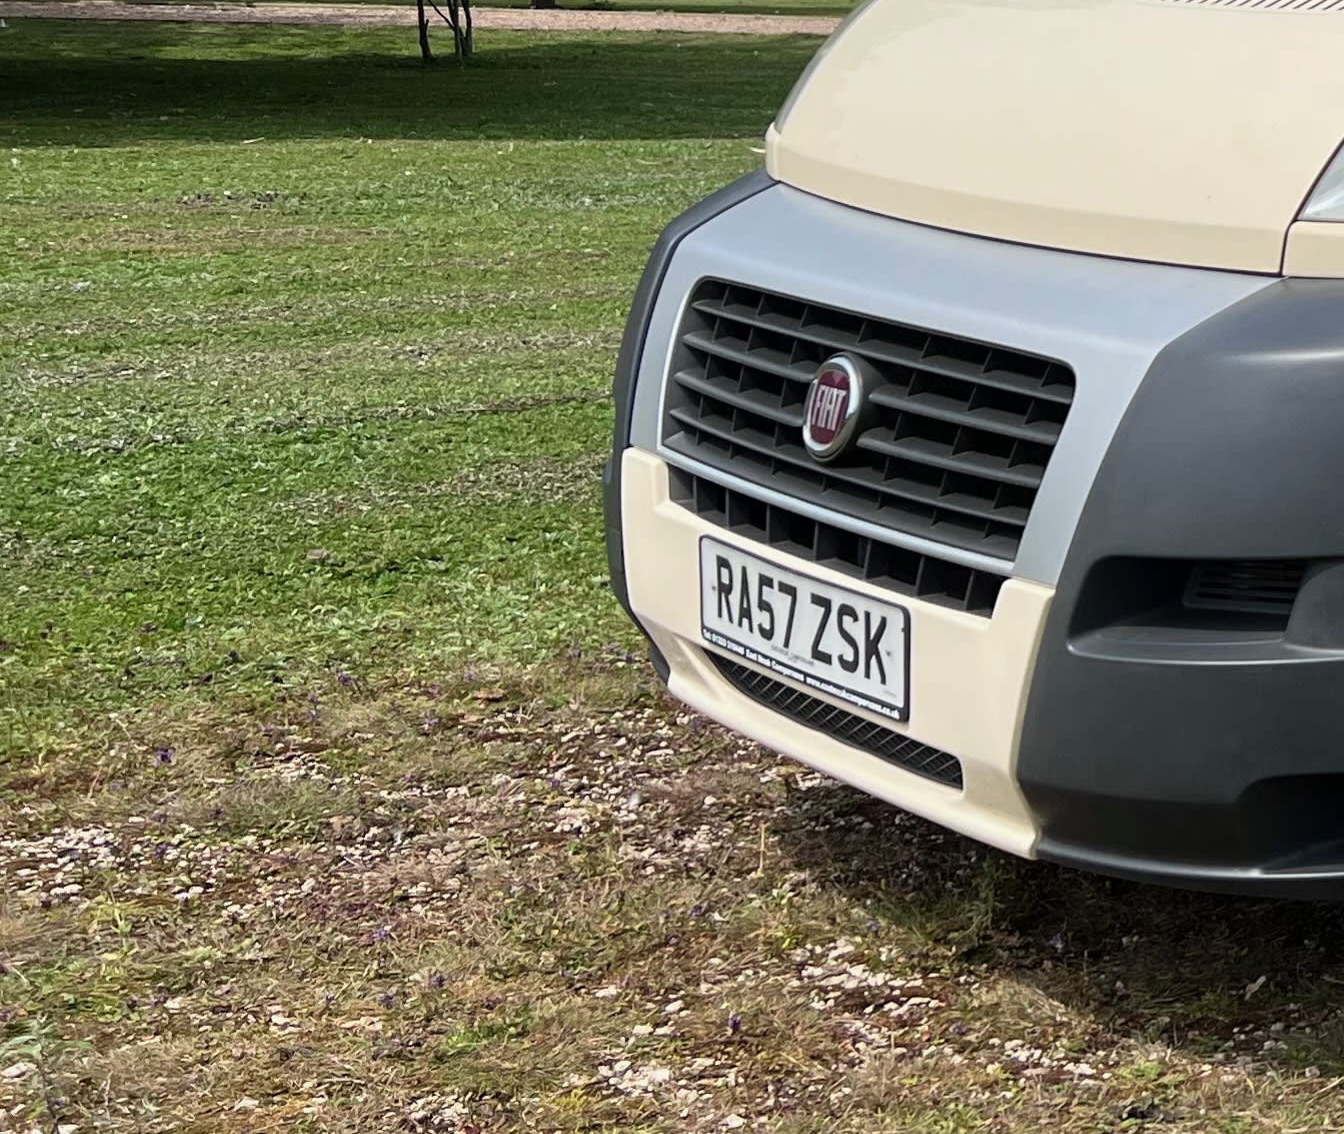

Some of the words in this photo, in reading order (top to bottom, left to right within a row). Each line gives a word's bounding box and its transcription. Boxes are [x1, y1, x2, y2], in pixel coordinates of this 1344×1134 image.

[811, 384, 847, 431] FIAT
[715, 553, 797, 649] RA57
[810, 592, 887, 686] ZSK
